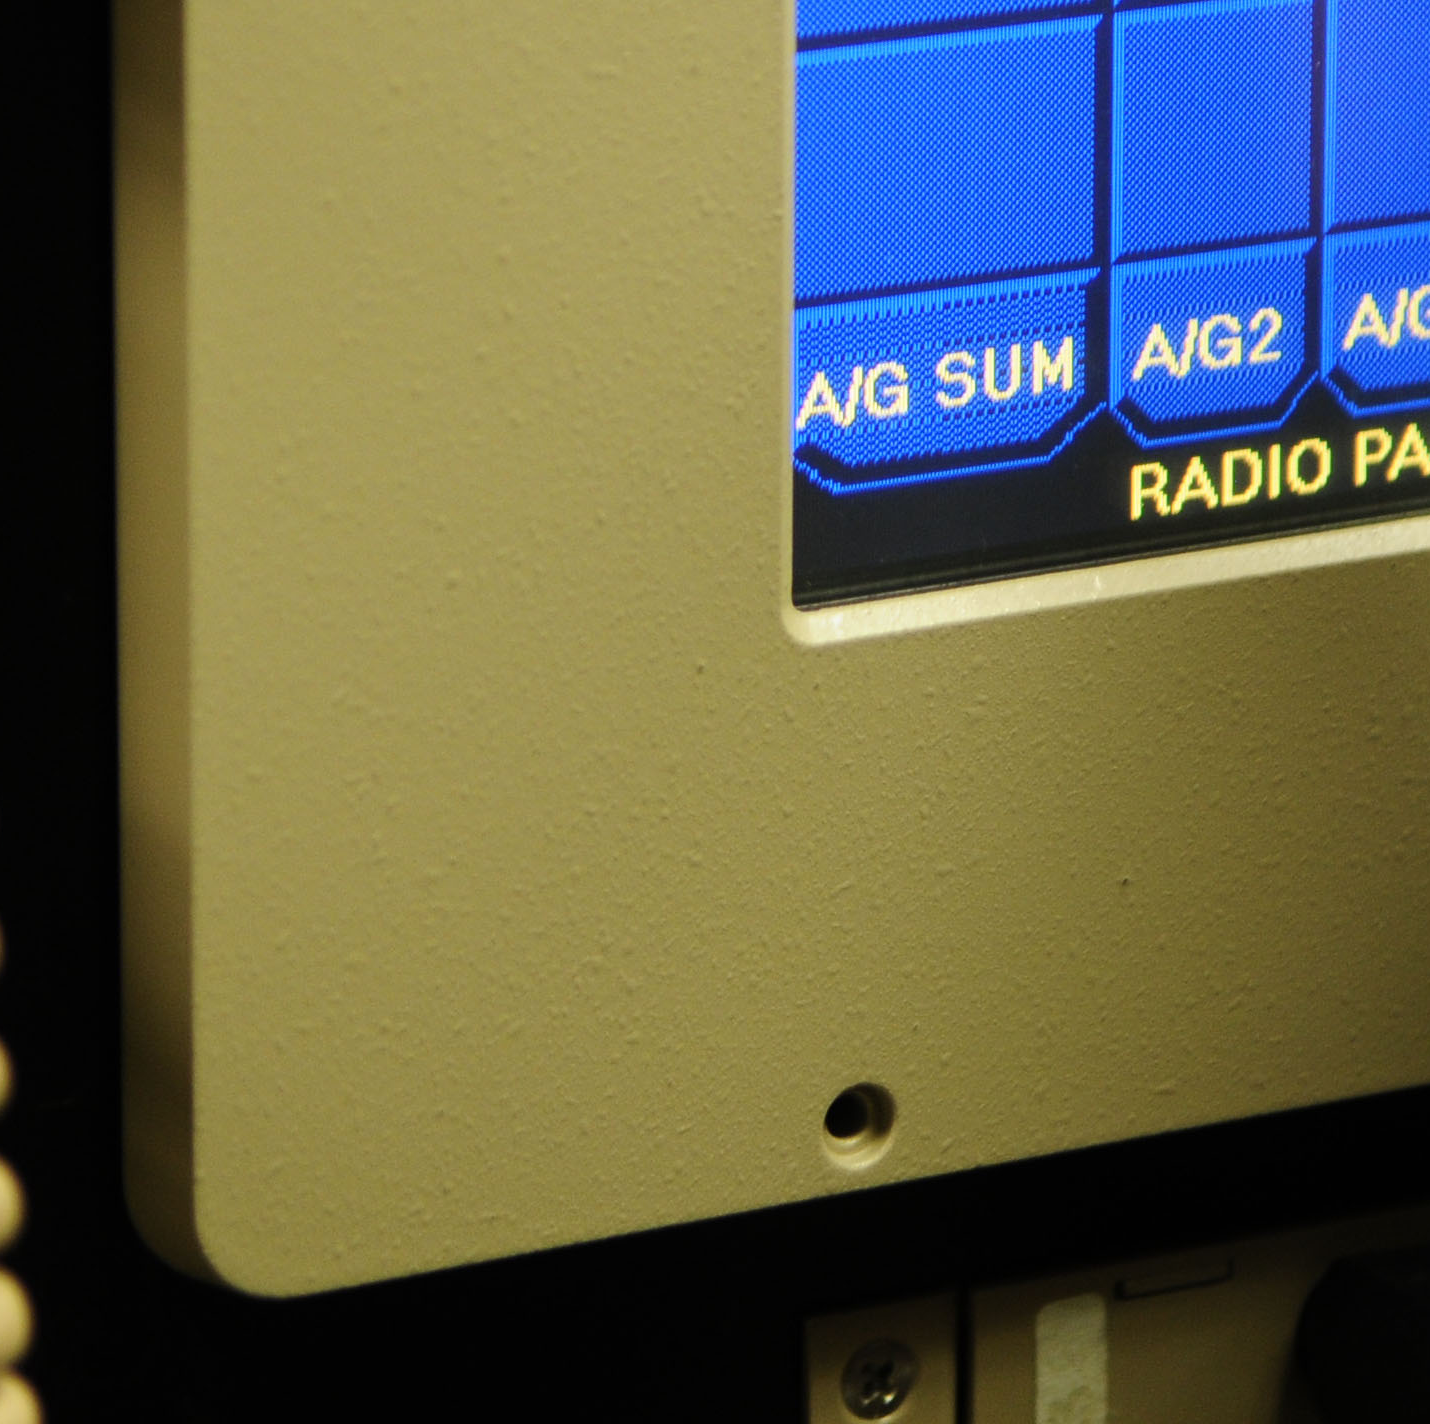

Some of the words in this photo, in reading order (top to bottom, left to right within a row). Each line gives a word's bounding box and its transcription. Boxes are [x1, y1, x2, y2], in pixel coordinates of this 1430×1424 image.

[796, 360, 910, 431] A/G
[934, 334, 1074, 410] SUM
[1131, 306, 1283, 382] A/G2
[1129, 436, 1332, 522] RADIO
